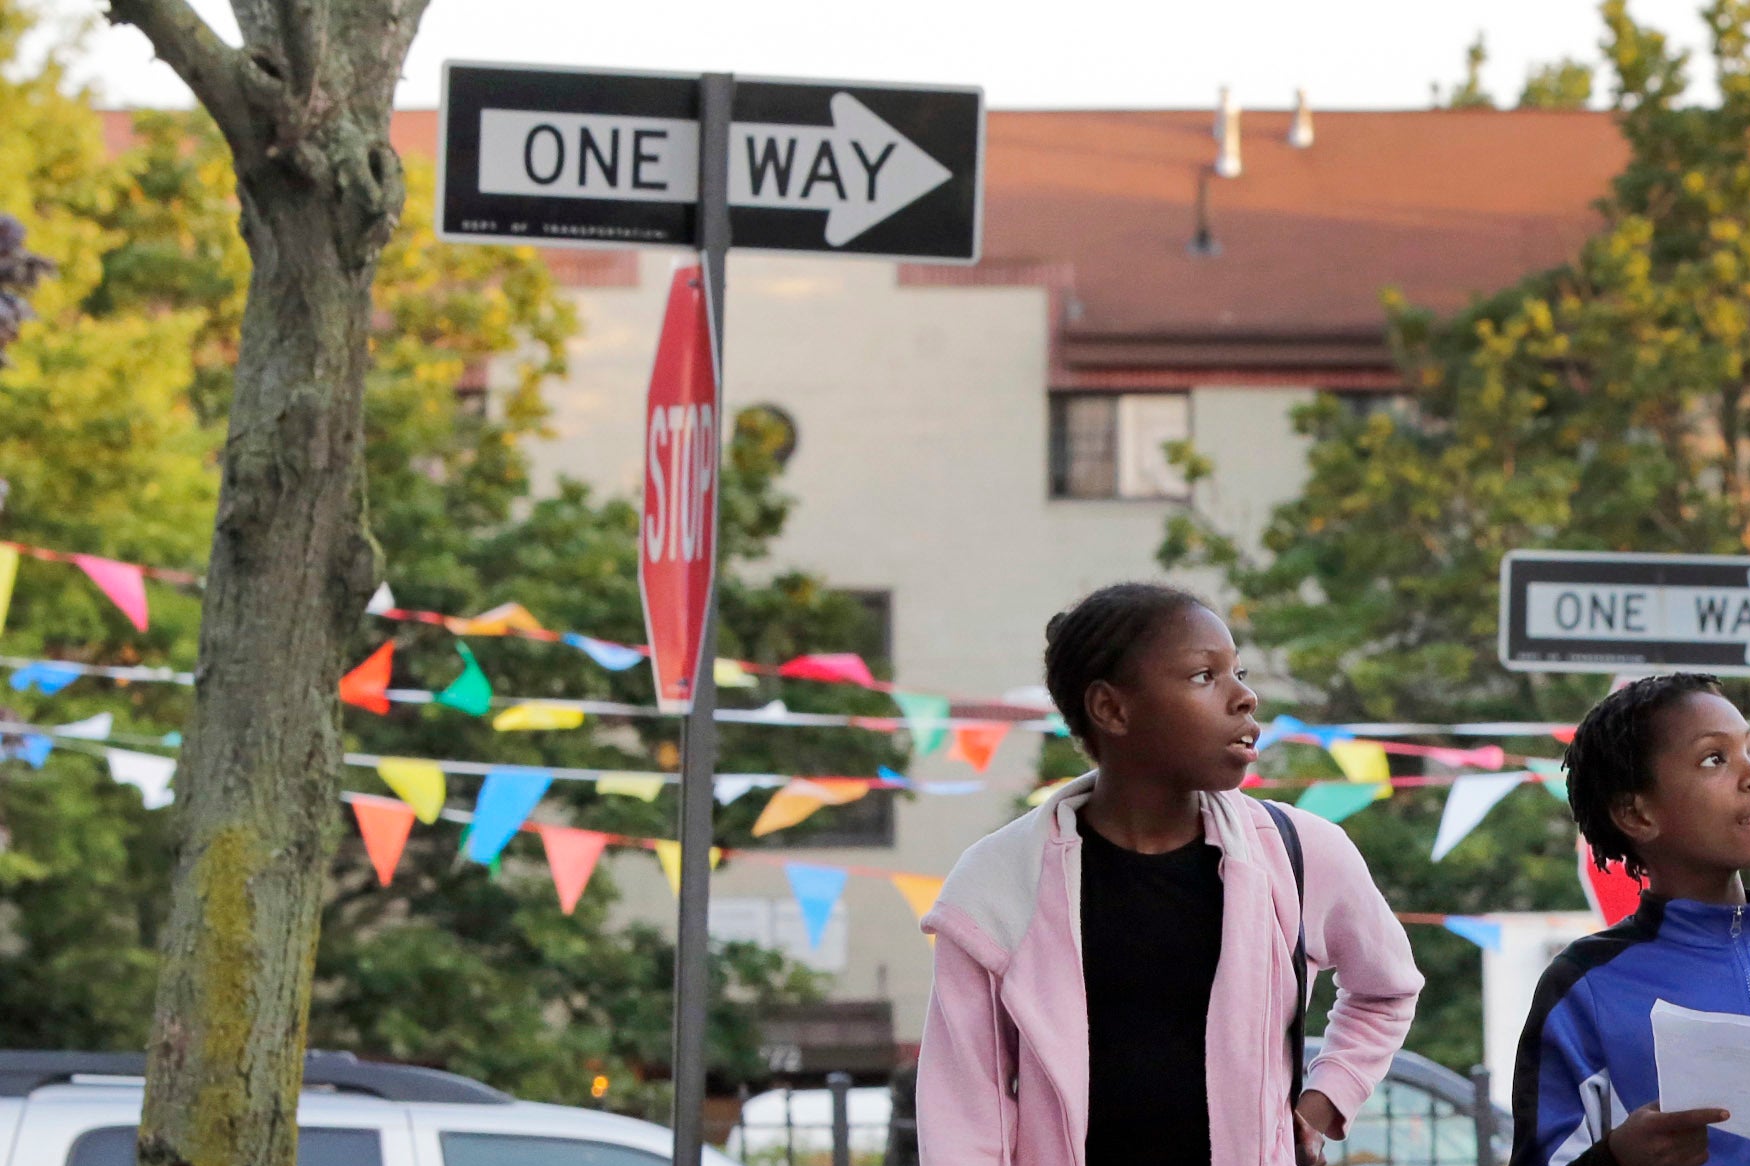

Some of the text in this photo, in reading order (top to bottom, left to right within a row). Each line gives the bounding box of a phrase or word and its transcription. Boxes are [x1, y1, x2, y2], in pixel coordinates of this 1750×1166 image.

[524, 123, 897, 201] ONE WAY
[646, 403, 713, 563] STOP
[1555, 591, 1646, 632] ONE
